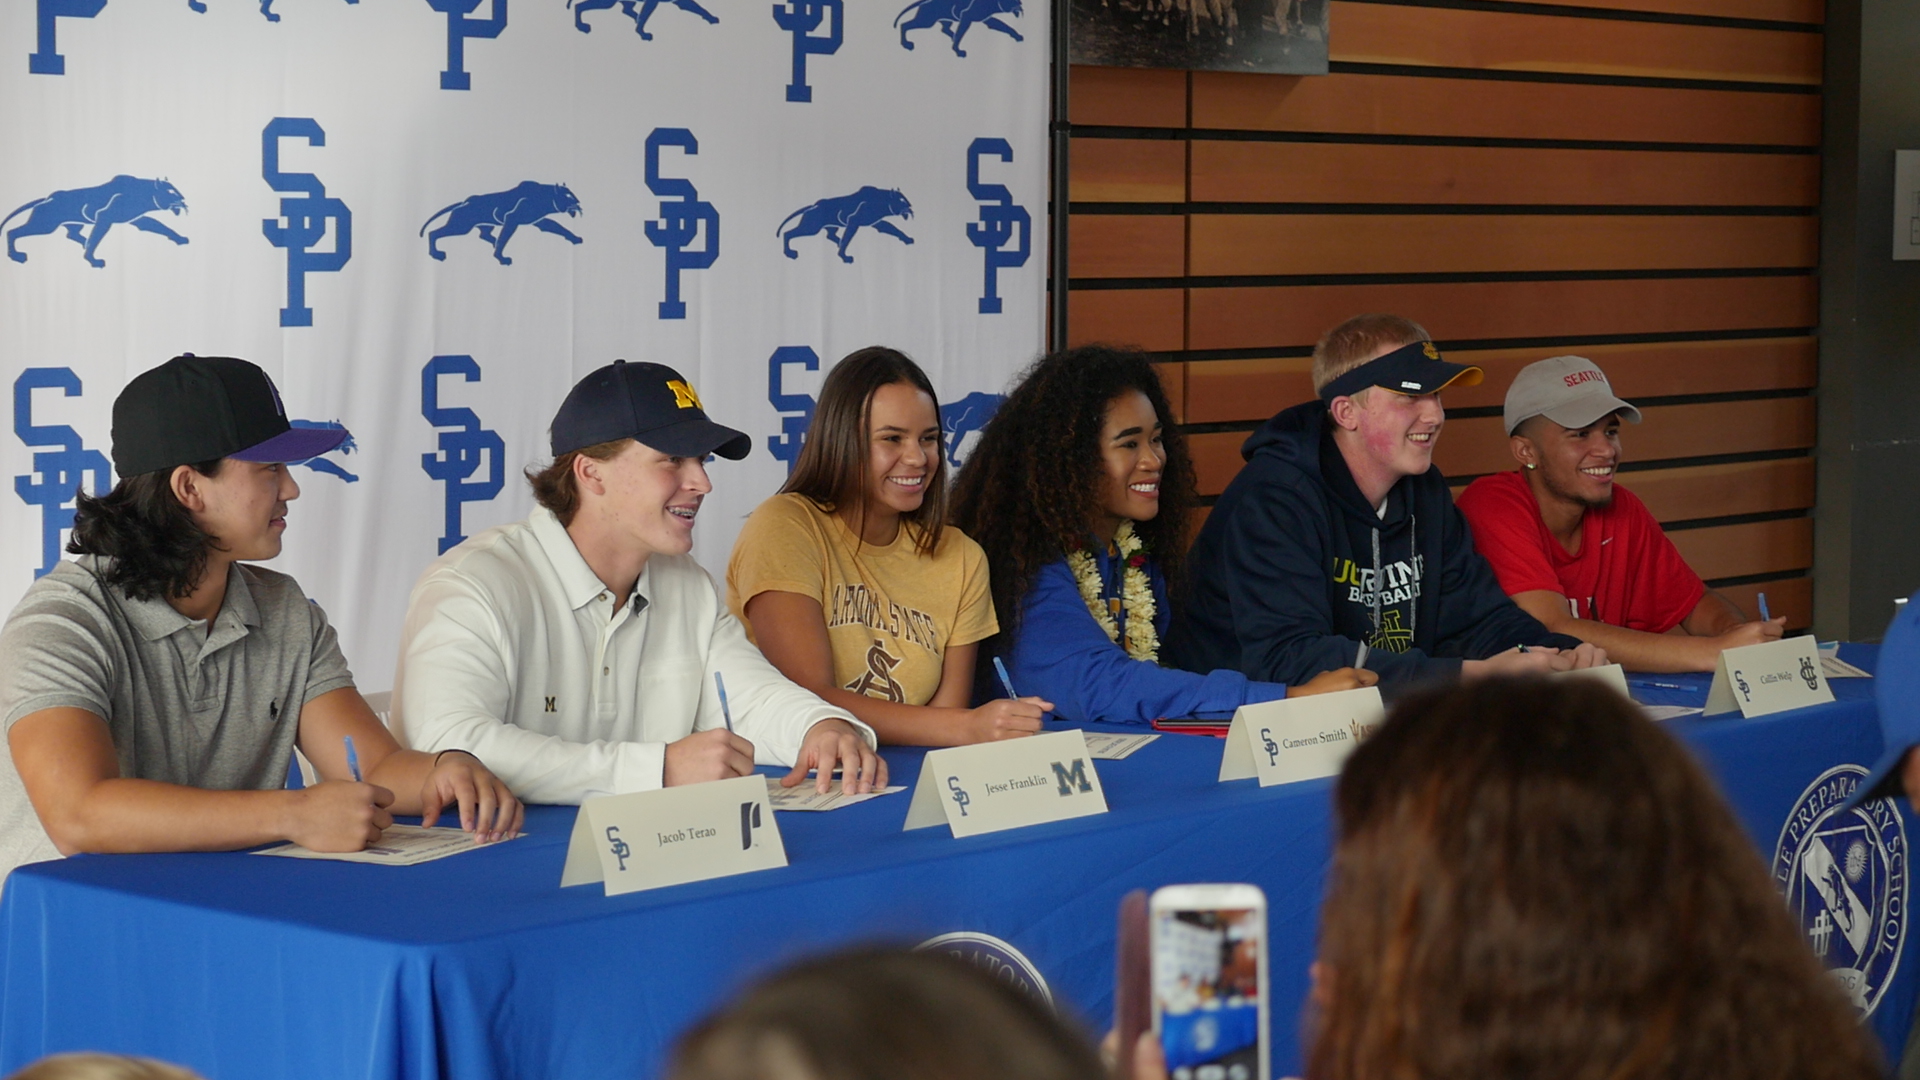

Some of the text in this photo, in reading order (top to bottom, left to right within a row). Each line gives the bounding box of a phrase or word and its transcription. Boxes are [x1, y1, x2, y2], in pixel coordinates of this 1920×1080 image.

[544, 696, 557, 713] M
[1282, 729, 1348, 749] Cameron Smith
[985, 775, 1048, 796] Jesse Franklin
[1050, 757, 1094, 798] M
[657, 826, 717, 848] Jacob Terao
[1880, 835, 1903, 954] SCHOOL
